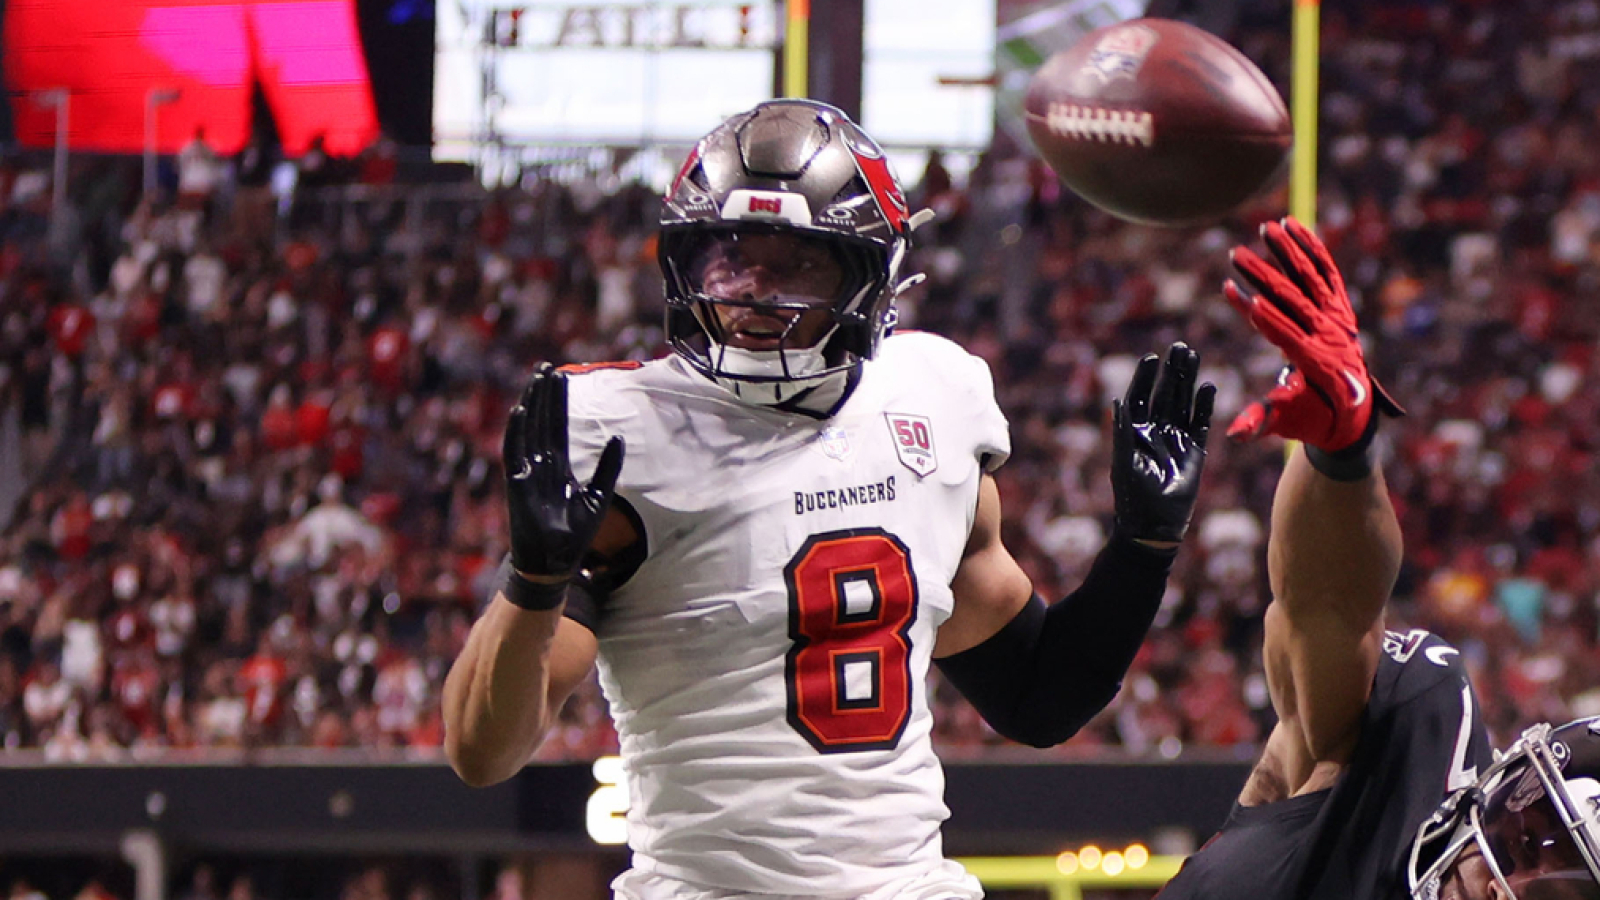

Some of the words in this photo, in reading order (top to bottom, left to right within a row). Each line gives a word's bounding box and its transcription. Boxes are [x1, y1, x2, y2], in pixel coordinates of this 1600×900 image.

[893, 419, 930, 450] 50
[794, 475, 896, 515] BUCCANEERS
[784, 527, 919, 754] 8
